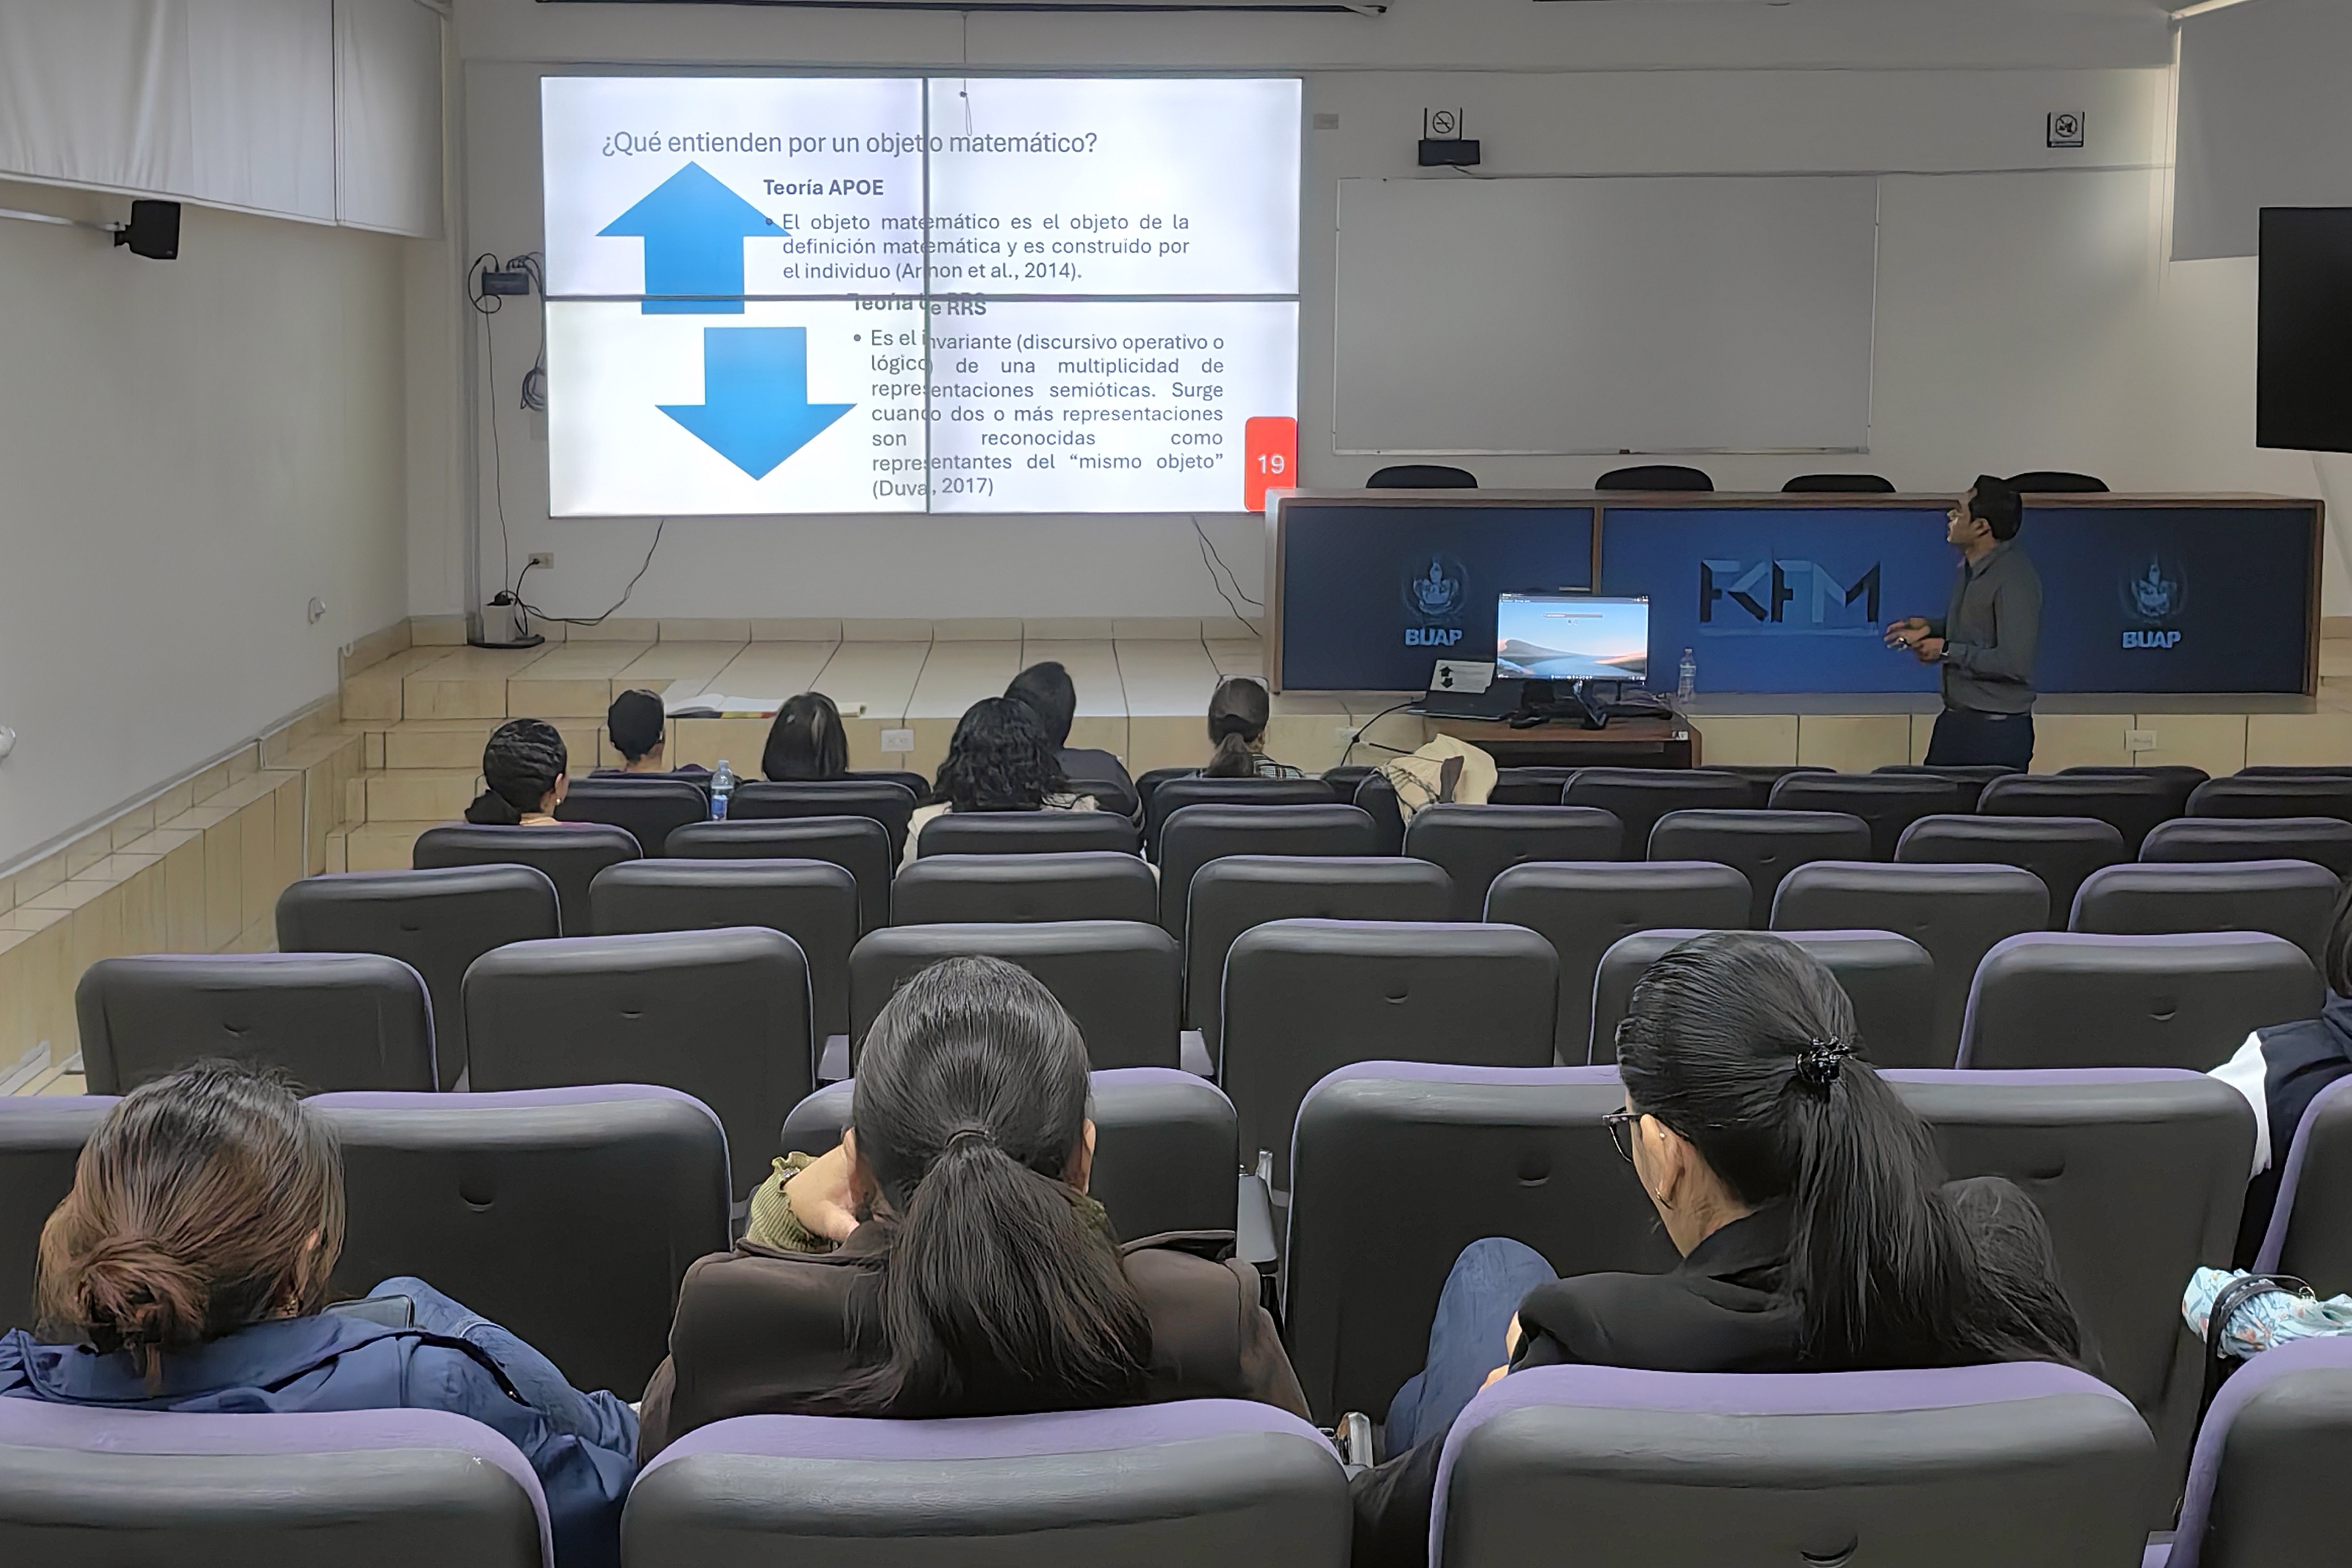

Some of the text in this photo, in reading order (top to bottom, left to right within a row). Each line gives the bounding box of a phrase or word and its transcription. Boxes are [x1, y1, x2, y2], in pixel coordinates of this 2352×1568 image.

[603, 131, 1098, 159] ¿Qué entienden por un objeto matemático?
[763, 179, 884, 196] Teoría APOE
[783, 213, 1189, 234] El objeto matemático es el objeto de la
[783, 237, 1190, 258] definición matemática y es construido por
[784, 263, 1082, 283] el individuo (Arnon et al., 2014).
[872, 330, 894, 346] Es
[899, 330, 917, 346] el
[1017, 334, 1118, 354] (discursivo
[1123, 334, 1208, 354] operativo
[1213, 338, 1224, 350] o
[956, 358, 979, 374] de
[1001, 362, 1036, 374] una
[1059, 358, 1180, 376] multiplicidad
[1202, 358, 1224, 374] de
[1050, 382, 1156, 398] semióticas.
[1172, 382, 1224, 402] Surge
[951, 405, 985, 422] dos
[994, 410, 1005, 422] o
[1015, 406, 1054, 422] más
[1064, 406, 1223, 424] representaciones
[873, 431, 1223, 447] son reconocidas como
[1027, 454, 1056, 470] del
[1070, 453, 1142, 470] “mismo
[1157, 453, 1223, 473] objeto”
[1257, 454, 1285, 474] 19
[873, 478, 994, 500] (Duva, 2017)
[1404, 629, 1462, 646] BUAP
[2123, 631, 2180, 648] BUAP
